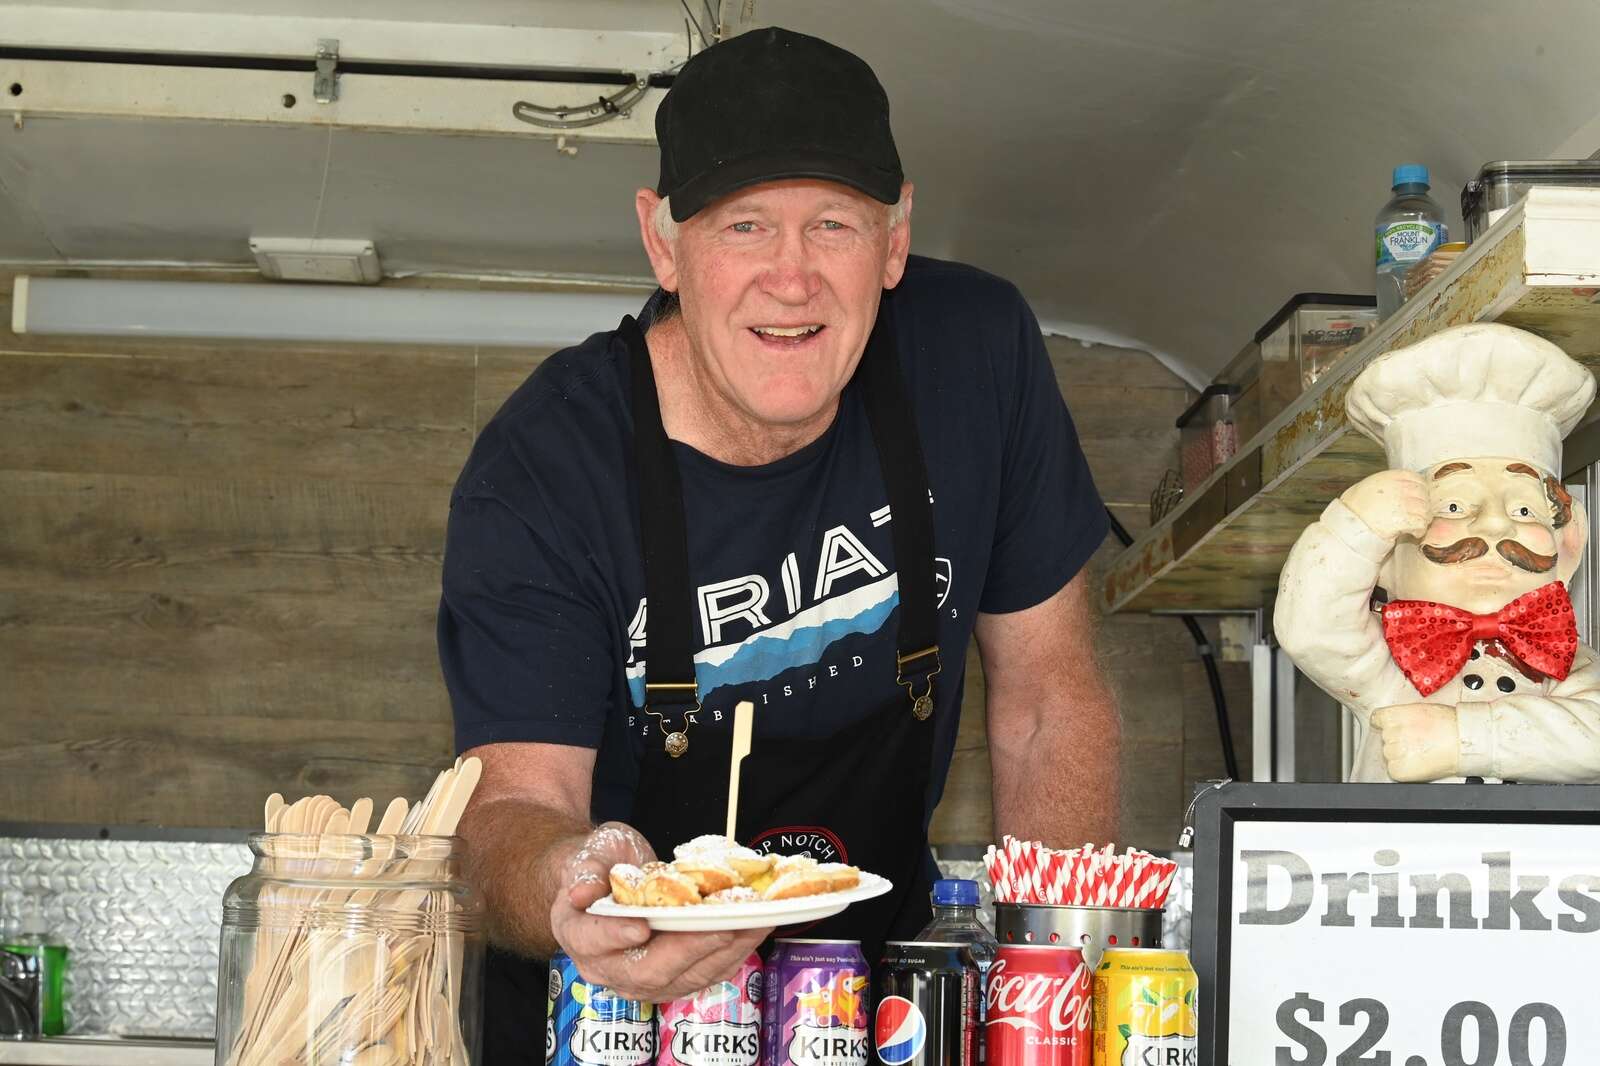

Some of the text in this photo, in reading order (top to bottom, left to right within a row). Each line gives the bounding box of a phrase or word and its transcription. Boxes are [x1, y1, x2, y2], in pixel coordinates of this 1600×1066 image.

[1389, 236, 1428, 246] FRANKLIN
[781, 834, 835, 860] NOTCH
[1238, 849, 1600, 933] Drinks
[987, 959, 1092, 1031] Coca-Co
[581, 1029, 652, 1053] KIRKS
[1026, 1036, 1078, 1046] CLASSIC
[1275, 992, 1567, 1066] $2.00
[681, 1031, 757, 1056] KIRKS
[800, 1036, 868, 1060] KIRKS
